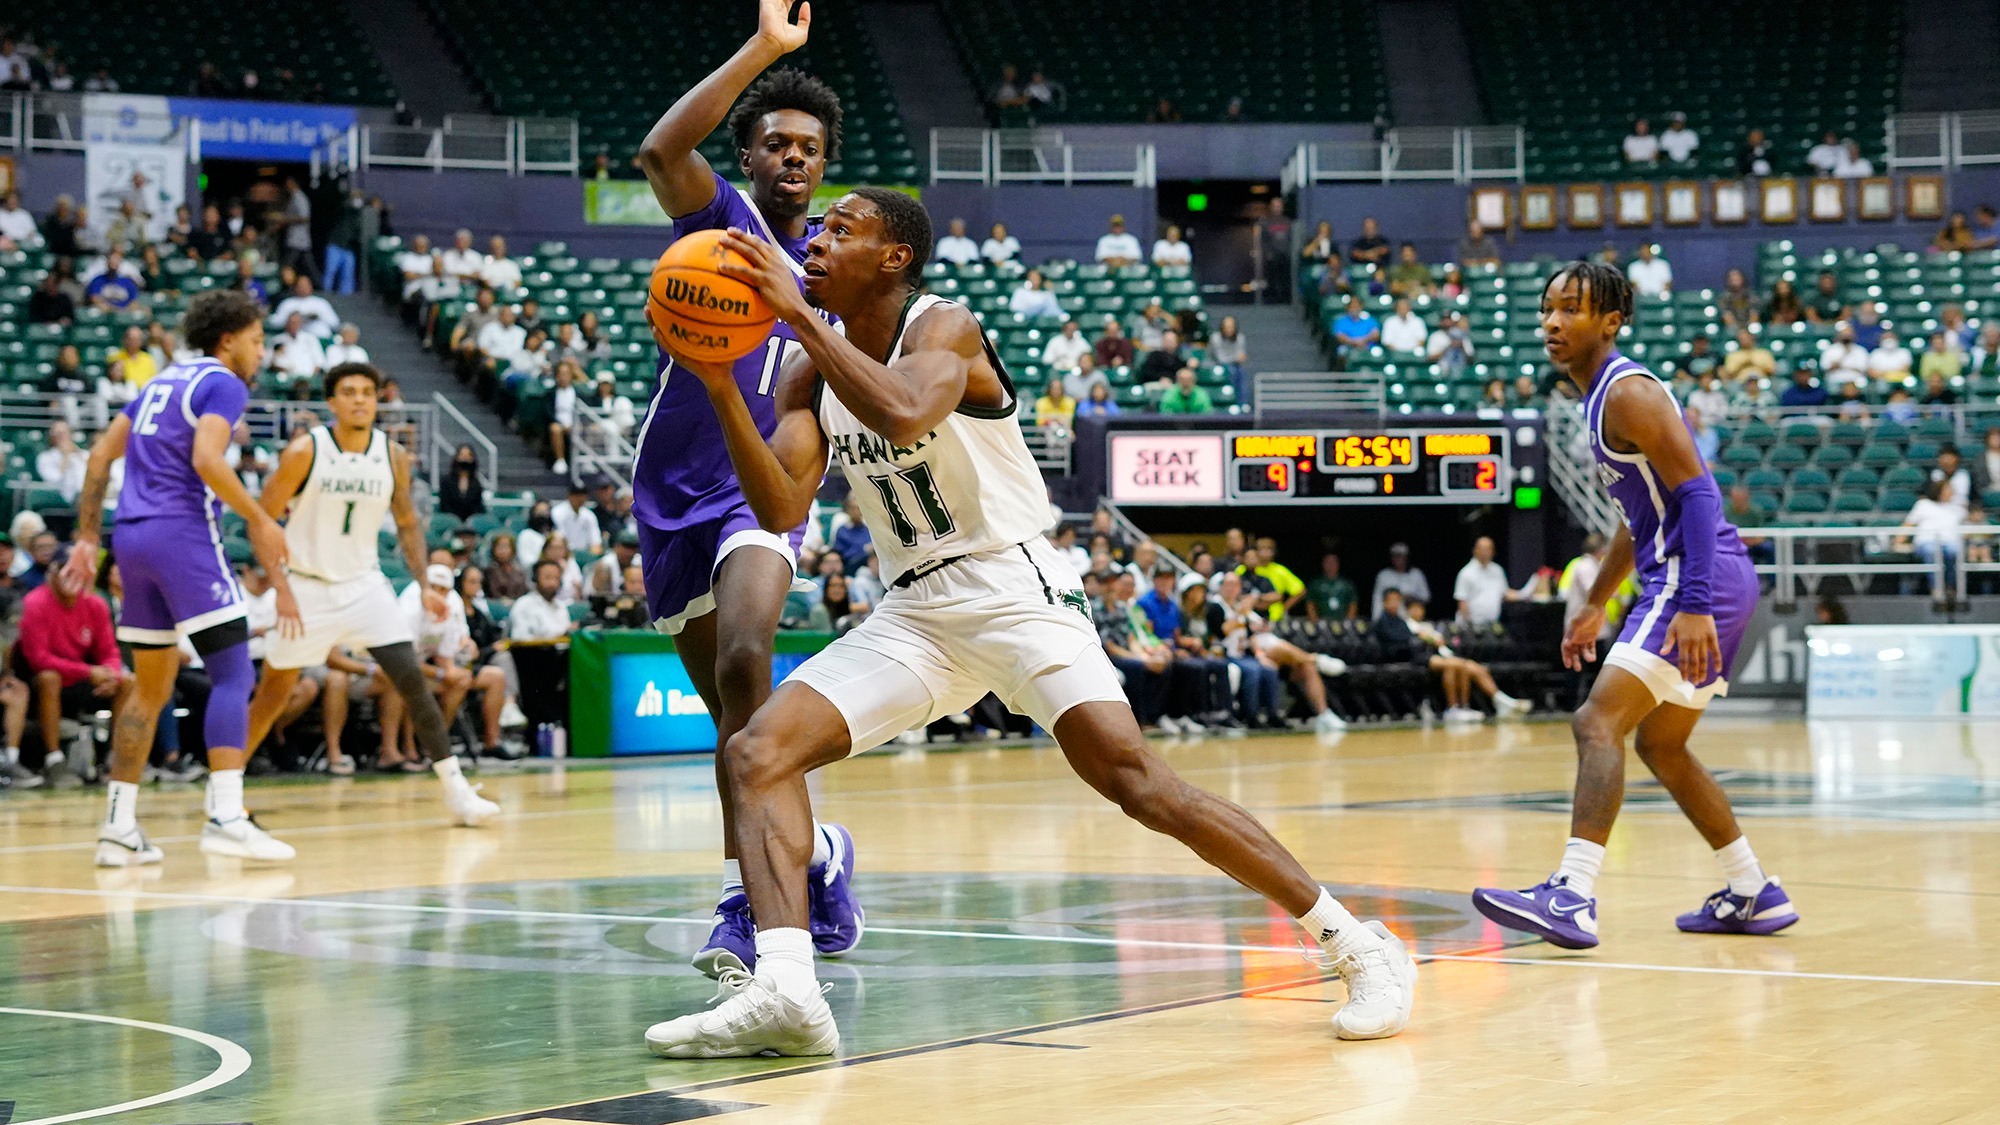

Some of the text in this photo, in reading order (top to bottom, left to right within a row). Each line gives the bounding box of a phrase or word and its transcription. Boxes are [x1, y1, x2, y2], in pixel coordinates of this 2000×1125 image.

[665, 277, 750, 317] Wilson
[669, 323, 729, 349] NCAA
[132, 383, 174, 436] 12
[1137, 450, 1199, 466] SEAT
[1335, 436, 1411, 467] 15:54
[321, 477, 383, 497] HAWAII
[1133, 470, 1200, 487] GEEK
[1267, 462, 1288, 491] 9
[1383, 473, 1394, 494] 1
[1476, 460, 1497, 491] 2
[341, 500, 356, 535] 1
[867, 461, 956, 547] 11
